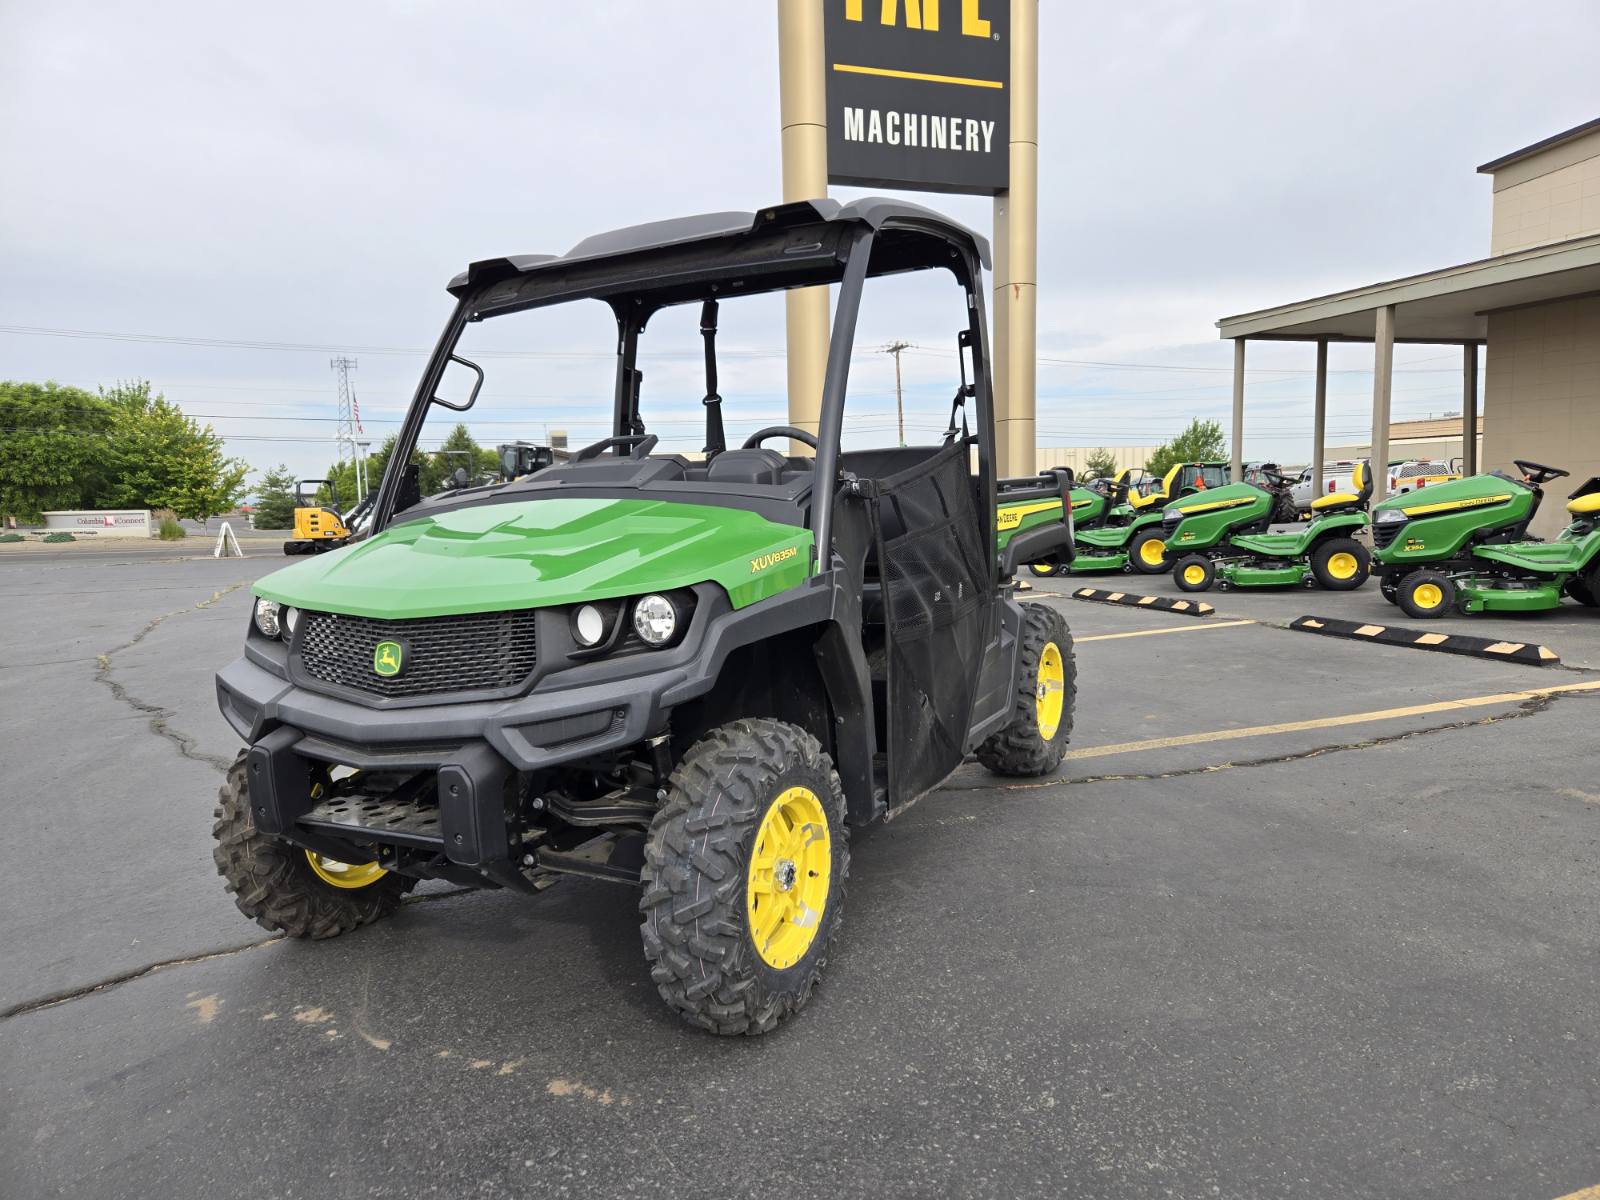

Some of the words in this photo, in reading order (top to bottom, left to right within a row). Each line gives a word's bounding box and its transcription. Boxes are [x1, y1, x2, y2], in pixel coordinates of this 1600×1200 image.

[843, 106, 995, 153] MACHINERY
[77, 516, 105, 525] Columbia
[1003, 512, 1018, 523] DEERE
[751, 546, 797, 574] XUV835M
